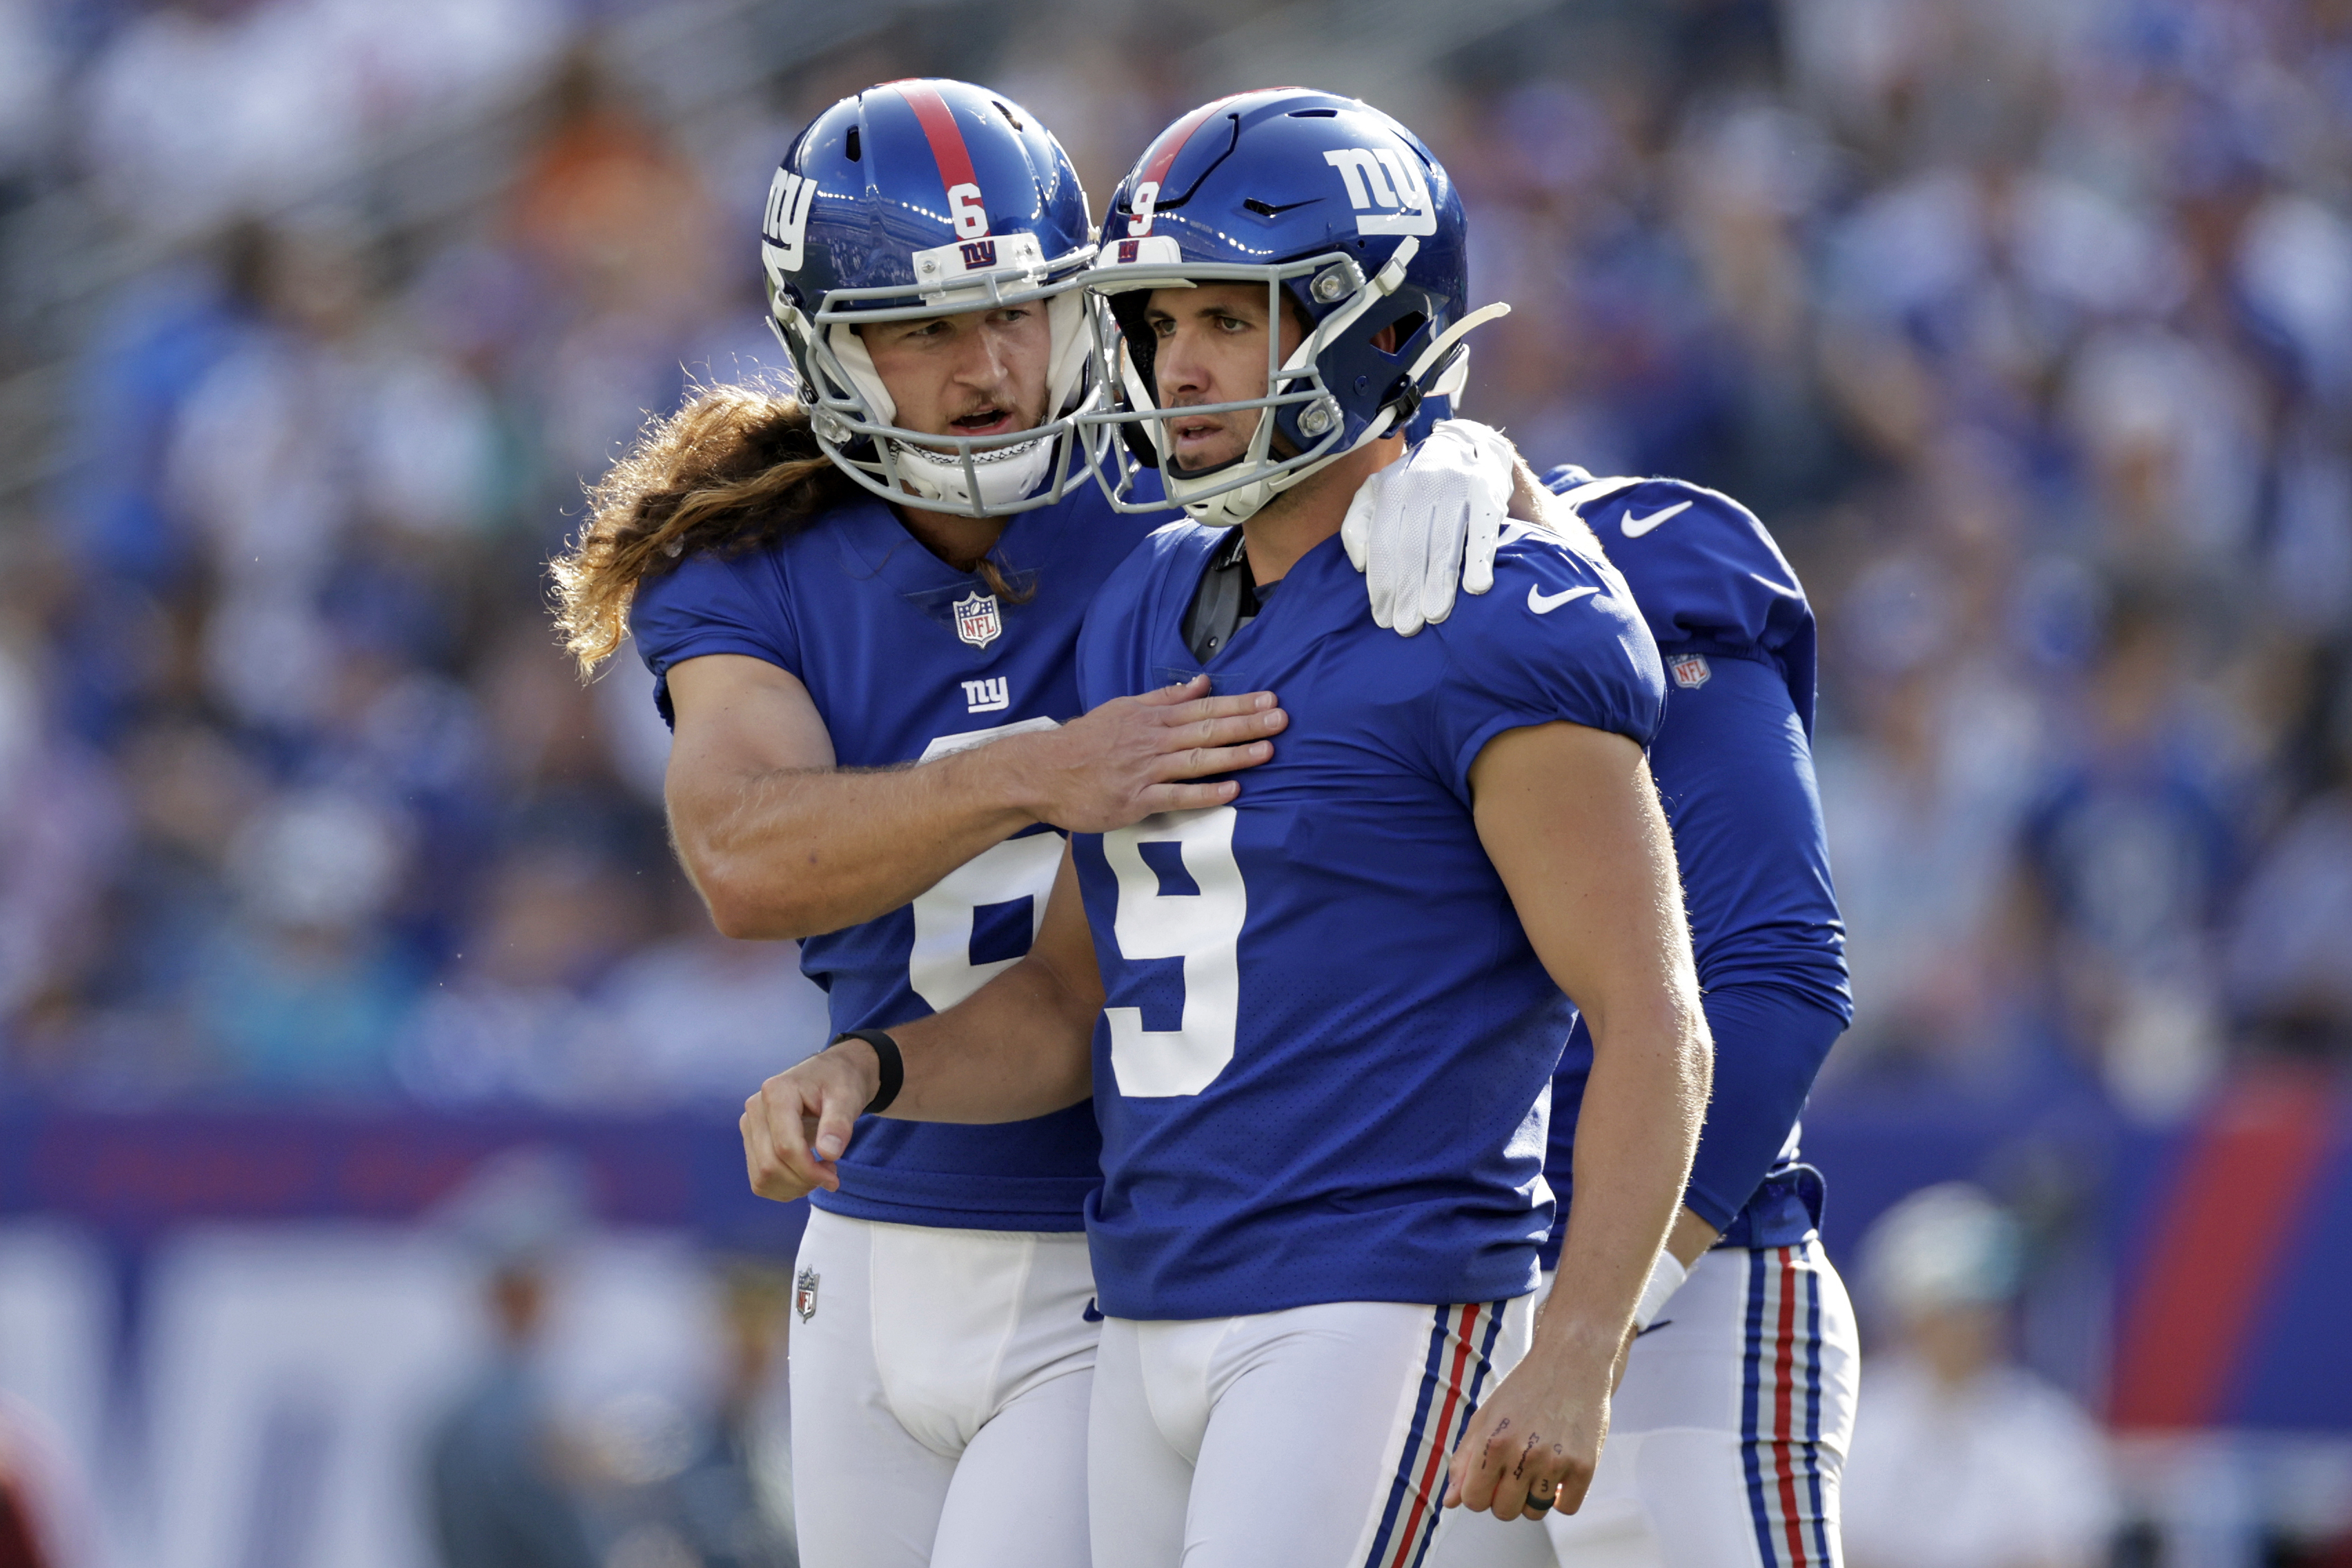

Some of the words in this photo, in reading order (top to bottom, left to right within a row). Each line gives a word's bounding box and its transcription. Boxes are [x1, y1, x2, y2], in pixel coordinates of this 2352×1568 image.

[947, 182, 989, 239] 6
[1127, 181, 1160, 237] 9
[1323, 147, 1437, 236] ny
[962, 615, 995, 637] NFL
[961, 675, 1010, 713] ny
[1675, 659, 1708, 682] NFL
[1103, 805, 1247, 1098] 9
